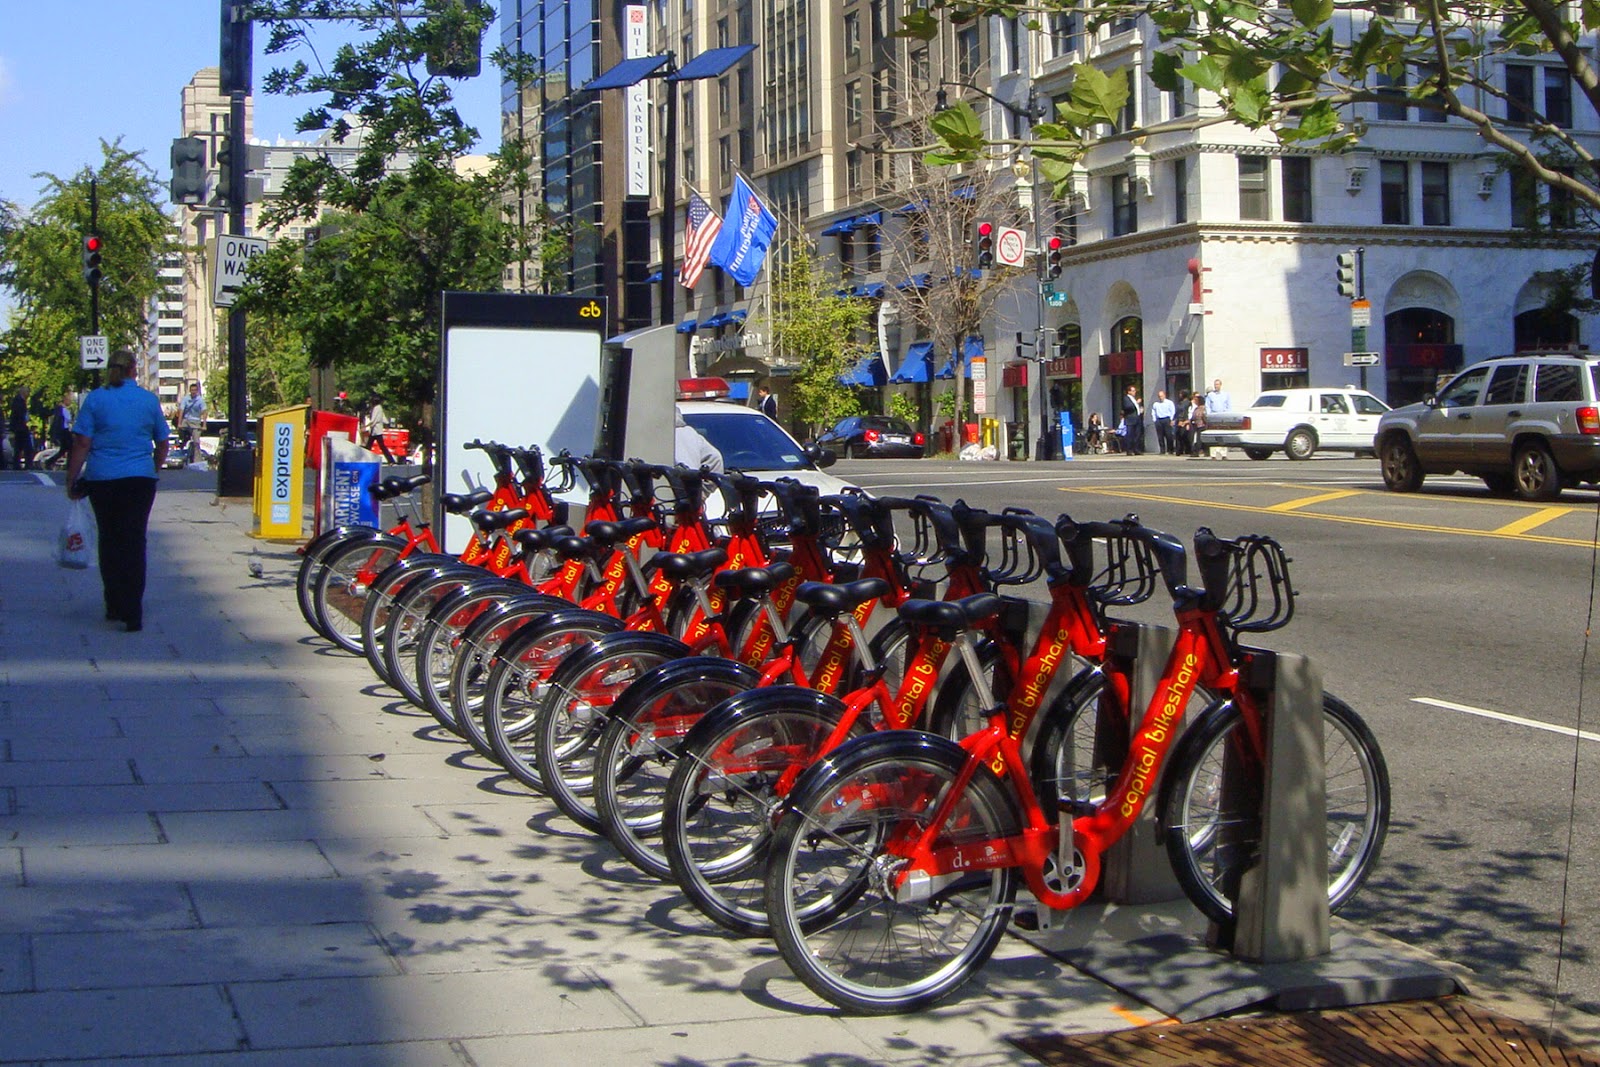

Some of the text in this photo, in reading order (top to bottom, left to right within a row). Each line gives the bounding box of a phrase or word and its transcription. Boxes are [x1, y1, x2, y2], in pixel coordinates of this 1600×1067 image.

[634, 94, 643, 155] GARDEN
[634, 161, 643, 190] INN
[224, 259, 249, 277] WA
[86, 338, 105, 346] ONE
[86, 347, 106, 355] WAY
[276, 426, 291, 499] express
[335, 468, 351, 528] ARTMENT
[350, 485, 361, 526] OWCASE
[748, 628, 772, 668] apital
[1017, 628, 1069, 708] bikeshare
[816, 650, 843, 692] apital
[897, 676, 926, 723] apital
[1120, 653, 1198, 818] capital bikeshare
